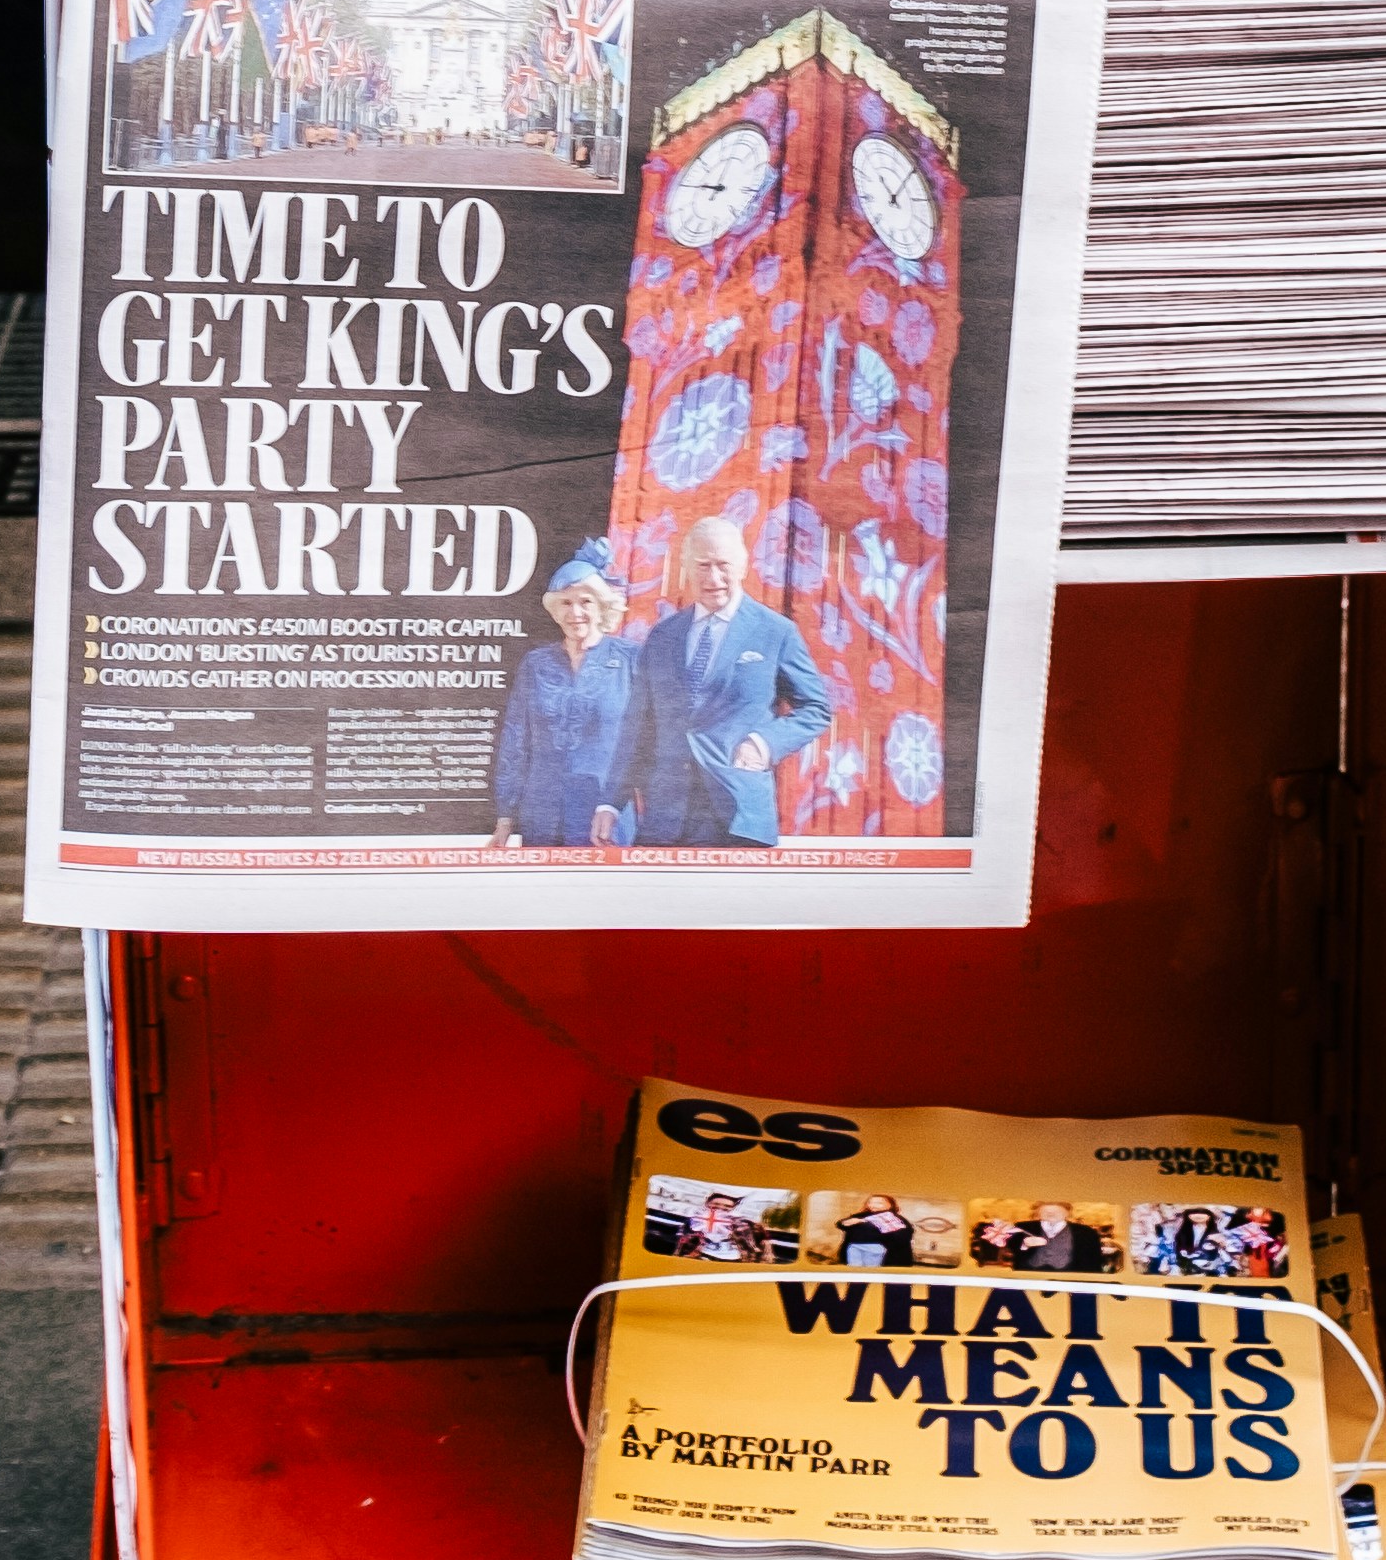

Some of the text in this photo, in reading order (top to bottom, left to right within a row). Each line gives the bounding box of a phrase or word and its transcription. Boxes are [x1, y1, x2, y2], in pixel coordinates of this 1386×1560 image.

[102, 184, 506, 293] TIME TO
[98, 289, 291, 390] GET
[92, 395, 423, 494] PARTY
[87, 499, 539, 598] STARTED
[258, 618, 329, 637] £450M
[331, 618, 400, 637] BOOST
[403, 619, 443, 637] FOR
[445, 619, 527, 638] CAPITAL
[101, 641, 192, 661] LONDON
[311, 644, 337, 662] AS
[340, 643, 439, 663] TOURISTS
[441, 644, 475, 663] FLY
[478, 644, 502, 663] IN
[100, 667, 506, 689] CROWDS GATHER ON PROCESSION ROUTE
[136, 850, 178, 865] NEW
[180, 851, 241, 866] RUSSIA
[243, 851, 314, 866] STRIKES
[315, 851, 338, 866] AS
[339, 851, 428, 866] ZELENSKY
[428, 850, 480, 865] VISITS
[550, 850, 592, 864] PAGE
[594, 850, 605, 864] 2
[621, 850, 899, 866] LOCAL ELECTIONS LATEST PAGE 7
[656, 1097, 862, 1162] es
[1094, 1146, 1279, 1169] CORONATION
[1158, 1159, 1282, 1182] SPECIAL
[776, 1278, 1294, 1345] WHAT IT
[848, 1339, 1296, 1414] MEANS
[620, 1440, 891, 1477] BY MARTIN PARR
[621, 1424, 833, 1456] A PORTFOLIO
[918, 1408, 1302, 1484] TO US
